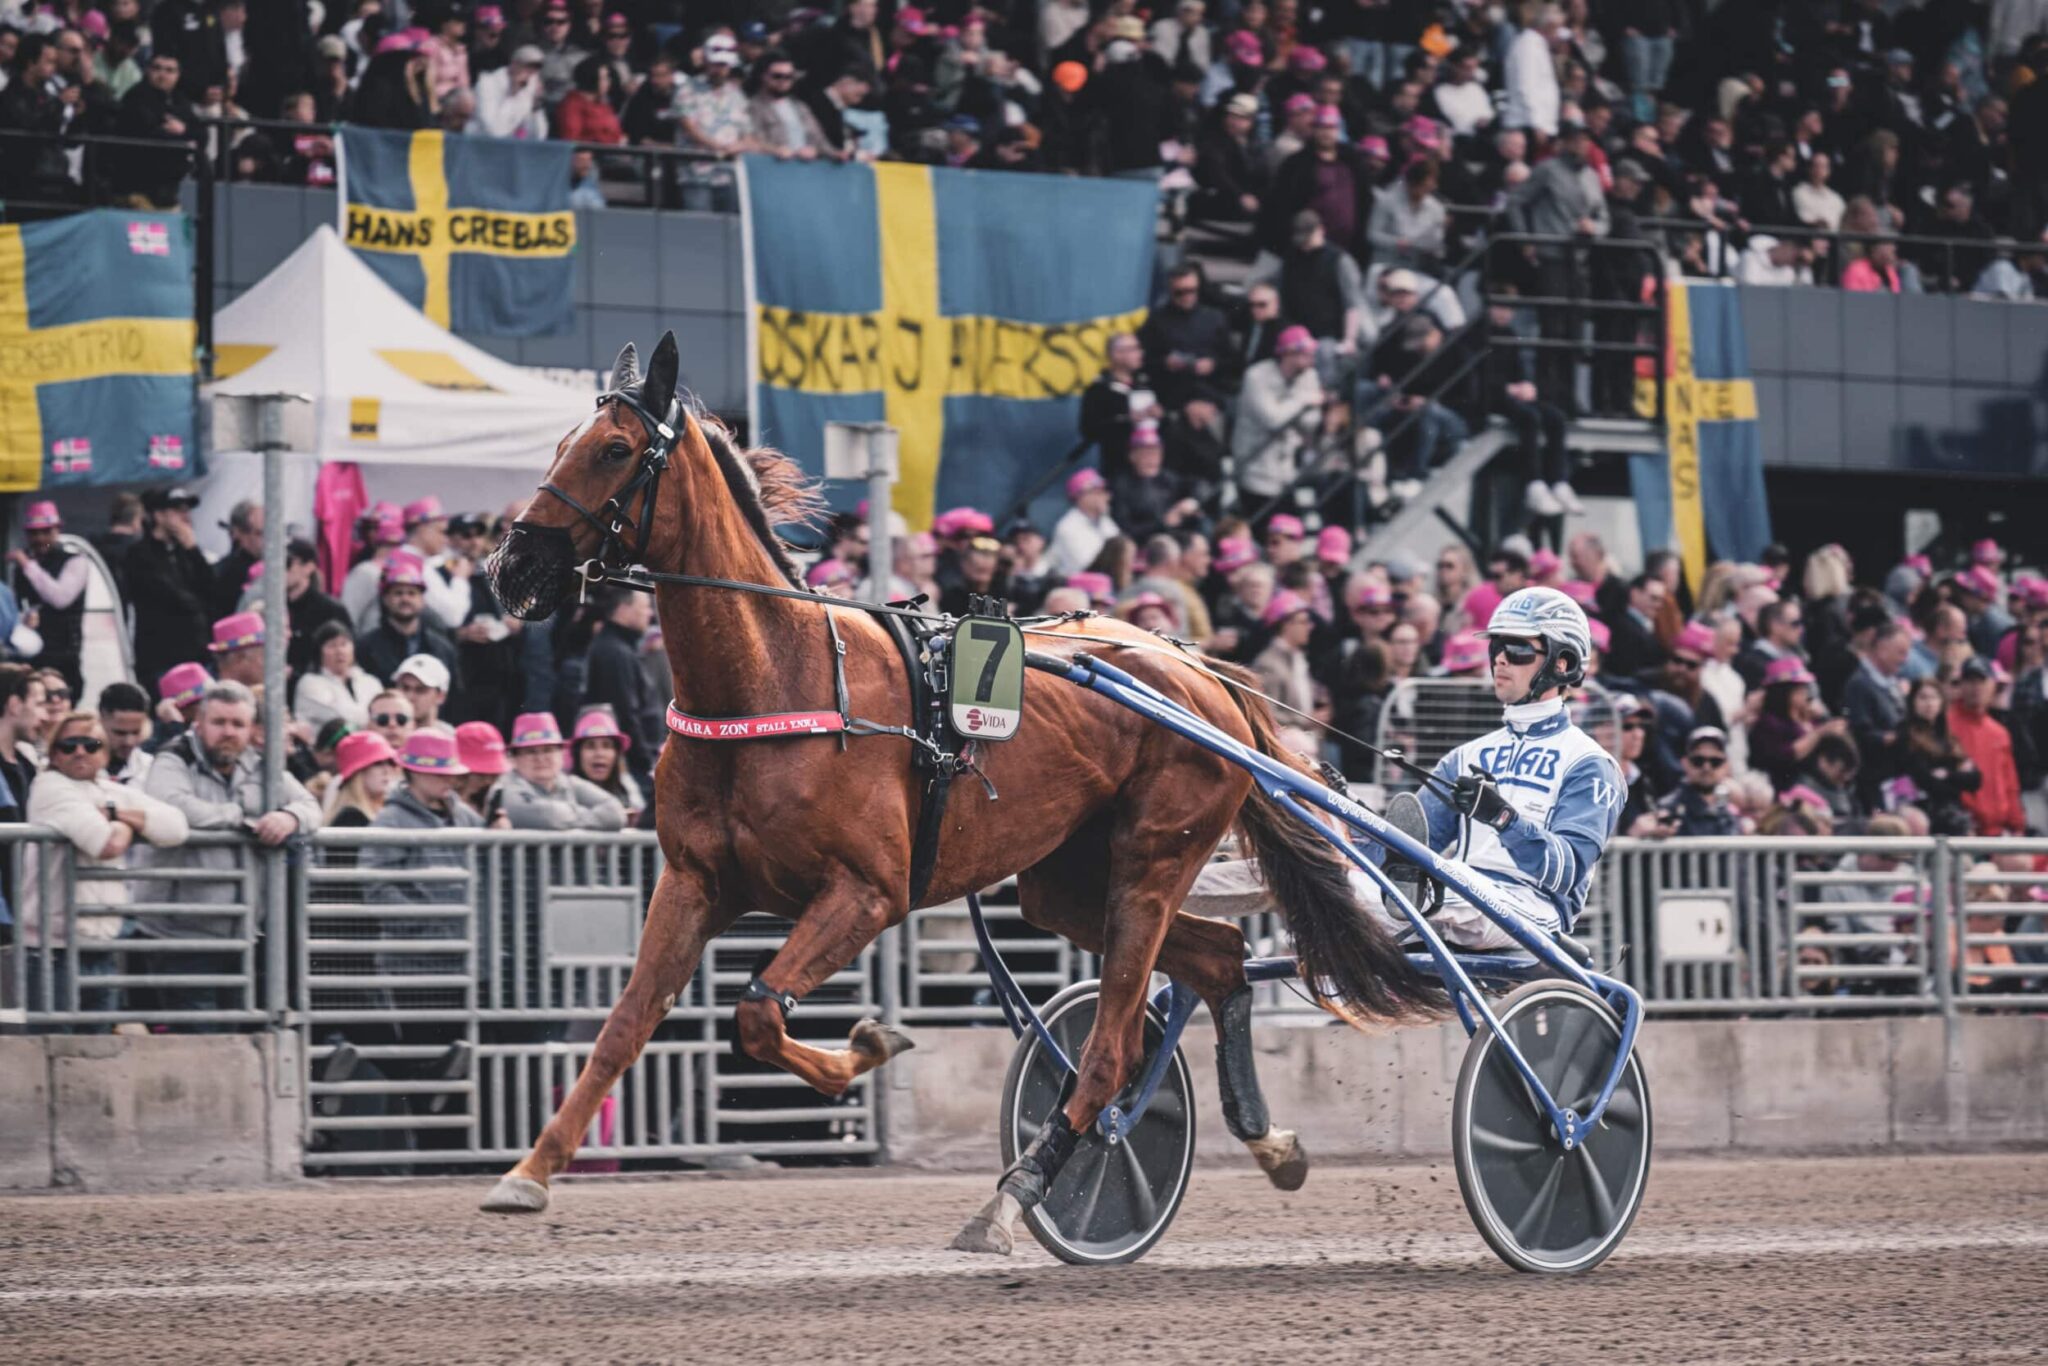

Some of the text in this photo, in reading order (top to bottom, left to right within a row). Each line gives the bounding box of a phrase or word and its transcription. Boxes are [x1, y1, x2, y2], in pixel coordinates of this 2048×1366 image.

[348, 212, 569, 249] HANS CREBAS
[894, 318, 922, 391] J
[970, 622, 1011, 703] 7
[720, 723, 749, 736] ZON
[756, 721, 788, 733] STALL
[982, 713, 1006, 729] VIDA
[1592, 777, 1619, 810] W
